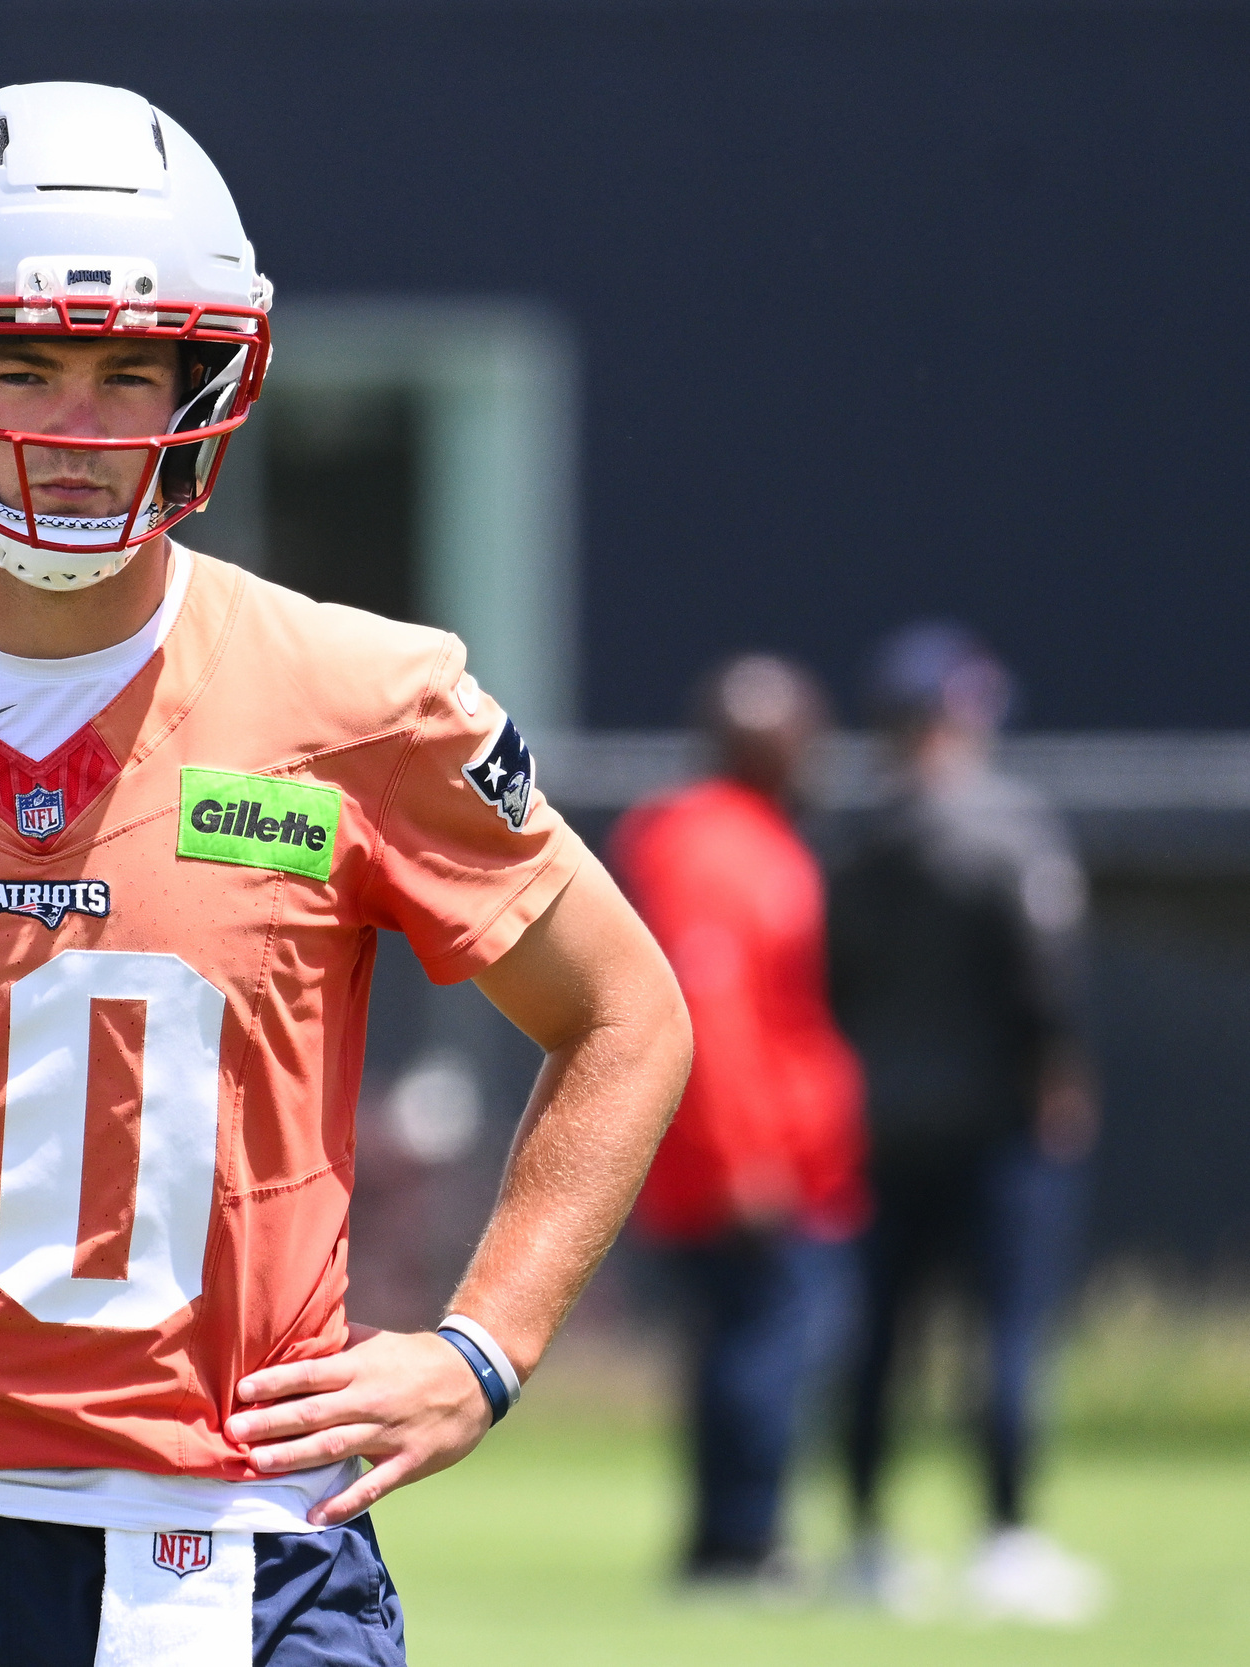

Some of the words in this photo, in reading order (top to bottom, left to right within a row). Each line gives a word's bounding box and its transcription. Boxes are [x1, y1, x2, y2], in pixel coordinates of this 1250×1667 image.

[67, 269, 111, 285] PATRIOTS
[24, 808, 57, 830] NFL
[191, 799, 327, 851] Gillette
[157, 1534, 206, 1570] NFL
